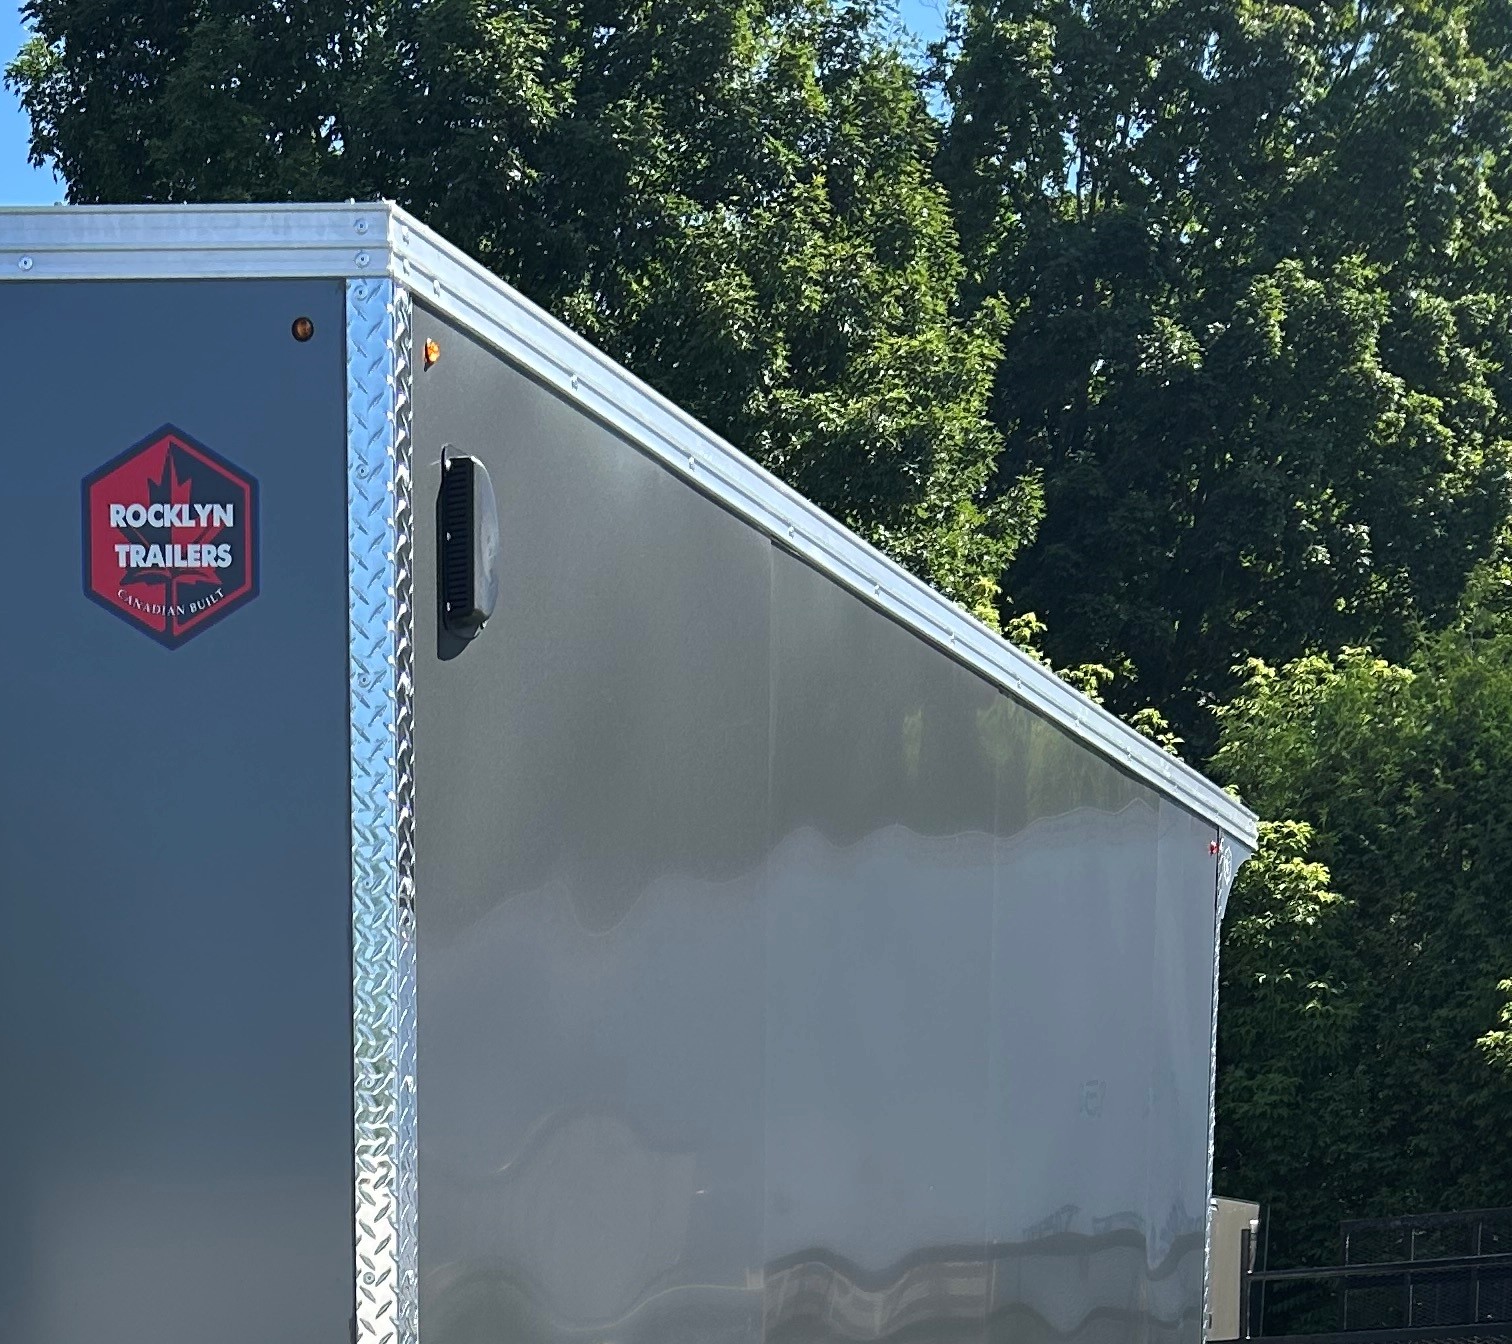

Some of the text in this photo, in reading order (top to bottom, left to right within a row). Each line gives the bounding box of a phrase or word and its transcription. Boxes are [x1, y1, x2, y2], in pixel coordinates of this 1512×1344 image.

[110, 503, 234, 527] ROCKLYN
[115, 543, 233, 568] TRAILERS
[117, 588, 225, 616] CANADIAN BUILT
